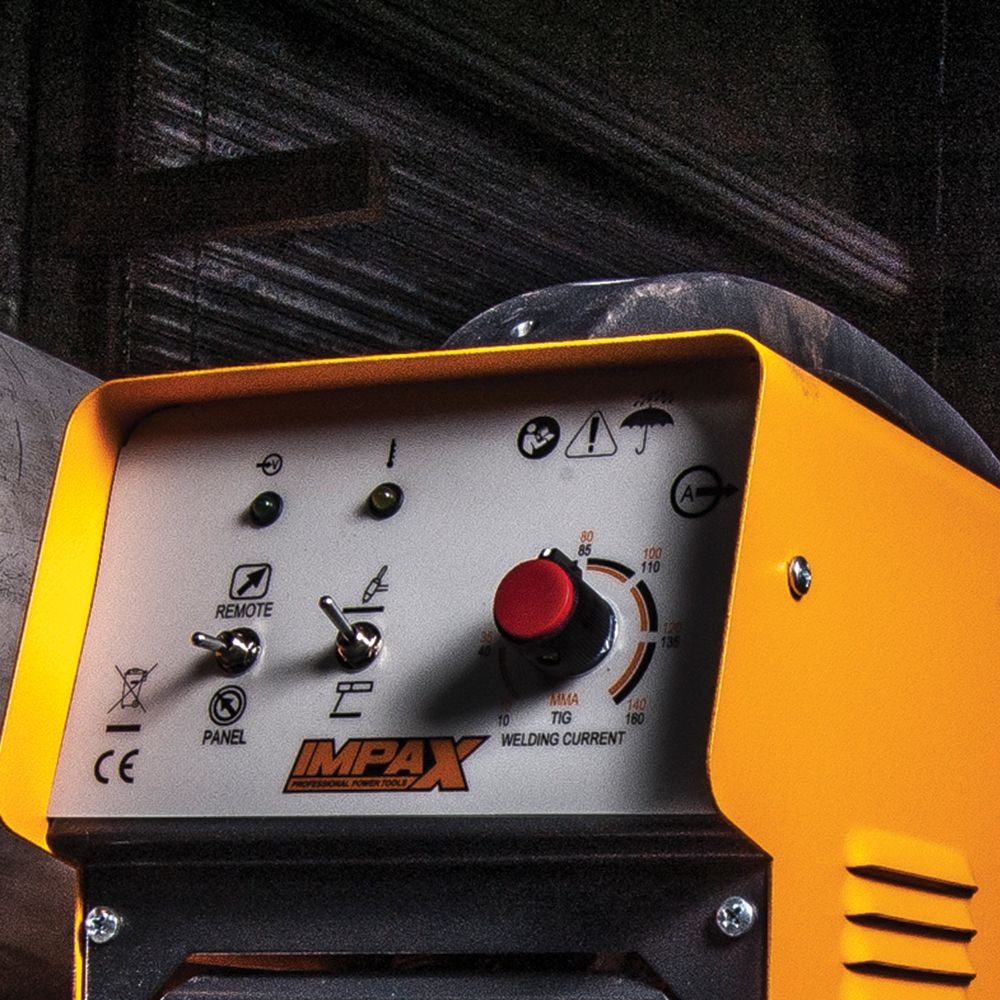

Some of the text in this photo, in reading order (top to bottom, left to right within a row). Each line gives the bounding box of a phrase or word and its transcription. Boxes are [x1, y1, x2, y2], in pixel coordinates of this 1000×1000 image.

[579, 530, 594, 543] 80
[577, 544, 592, 556] 85
[643, 547, 663, 559] 100
[641, 560, 661, 573] 110
[215, 602, 274, 619] REMOTE
[550, 692, 579, 706] MMA
[627, 698, 647, 711] 140
[498, 714, 510, 727] 10
[551, 711, 572, 725] TIG
[625, 712, 645, 725] 160
[202, 729, 247, 745] PANEL
[501, 731, 626, 747] WELDING CURRENT
[288, 735, 488, 791] IMPAX
[290, 779, 408, 788] PROFESSIONAL POWER TOOLS
